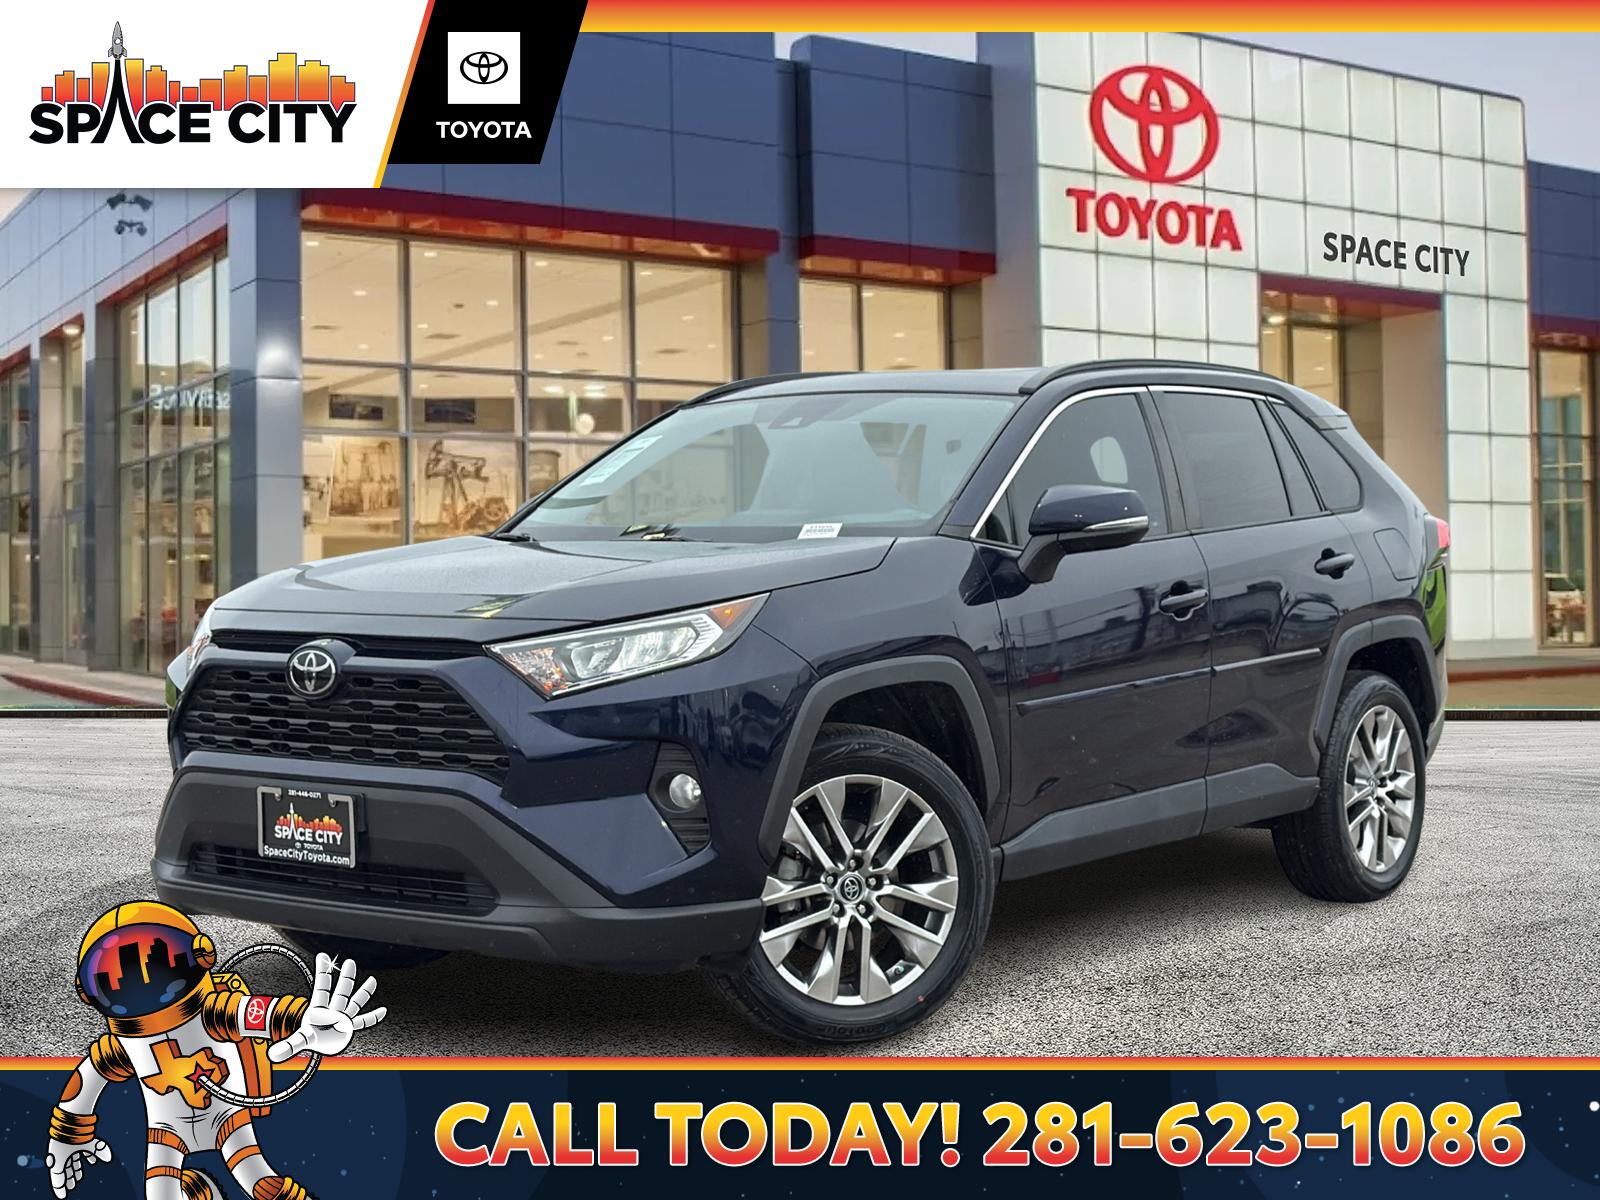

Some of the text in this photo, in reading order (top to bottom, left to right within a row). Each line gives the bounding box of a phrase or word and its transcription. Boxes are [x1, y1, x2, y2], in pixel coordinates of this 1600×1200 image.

[1066, 188, 1242, 251] TOYOTA
[1323, 231, 1470, 277] SPACE CITY
[274, 814, 343, 845] SPACE CITY
[264, 845, 350, 866] SpaceCityToyota.com
[303, 842, 324, 851] TOYOTA
